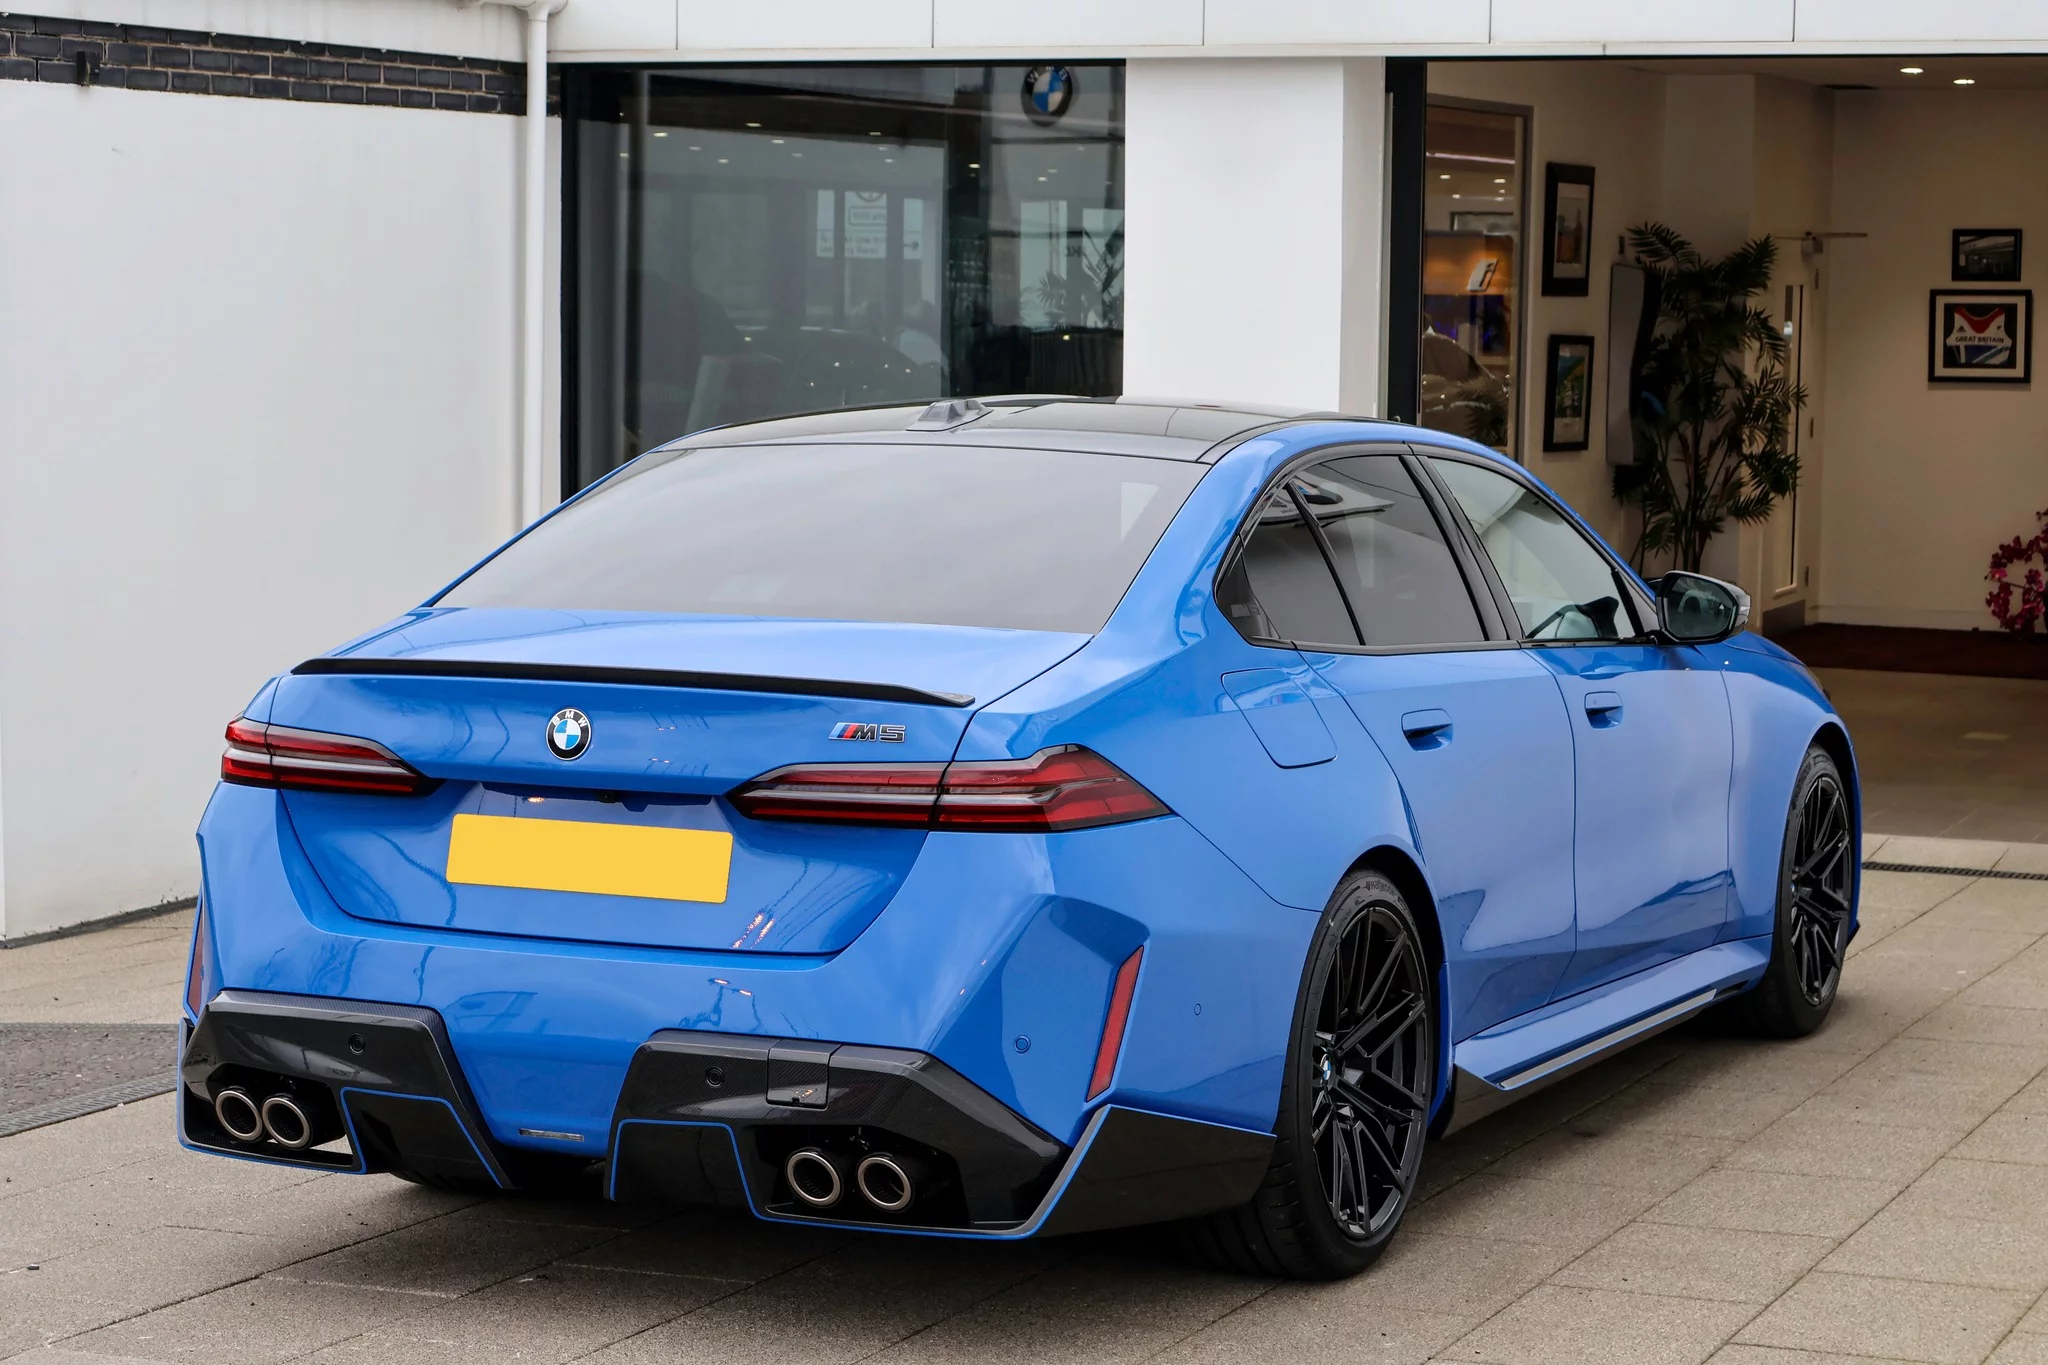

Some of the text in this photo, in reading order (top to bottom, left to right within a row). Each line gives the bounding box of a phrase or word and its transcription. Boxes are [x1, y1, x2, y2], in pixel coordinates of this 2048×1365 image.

[1977, 336, 2004, 344] BRITAIN
[551, 710, 588, 728] BMW
[829, 722, 906, 743] M5
